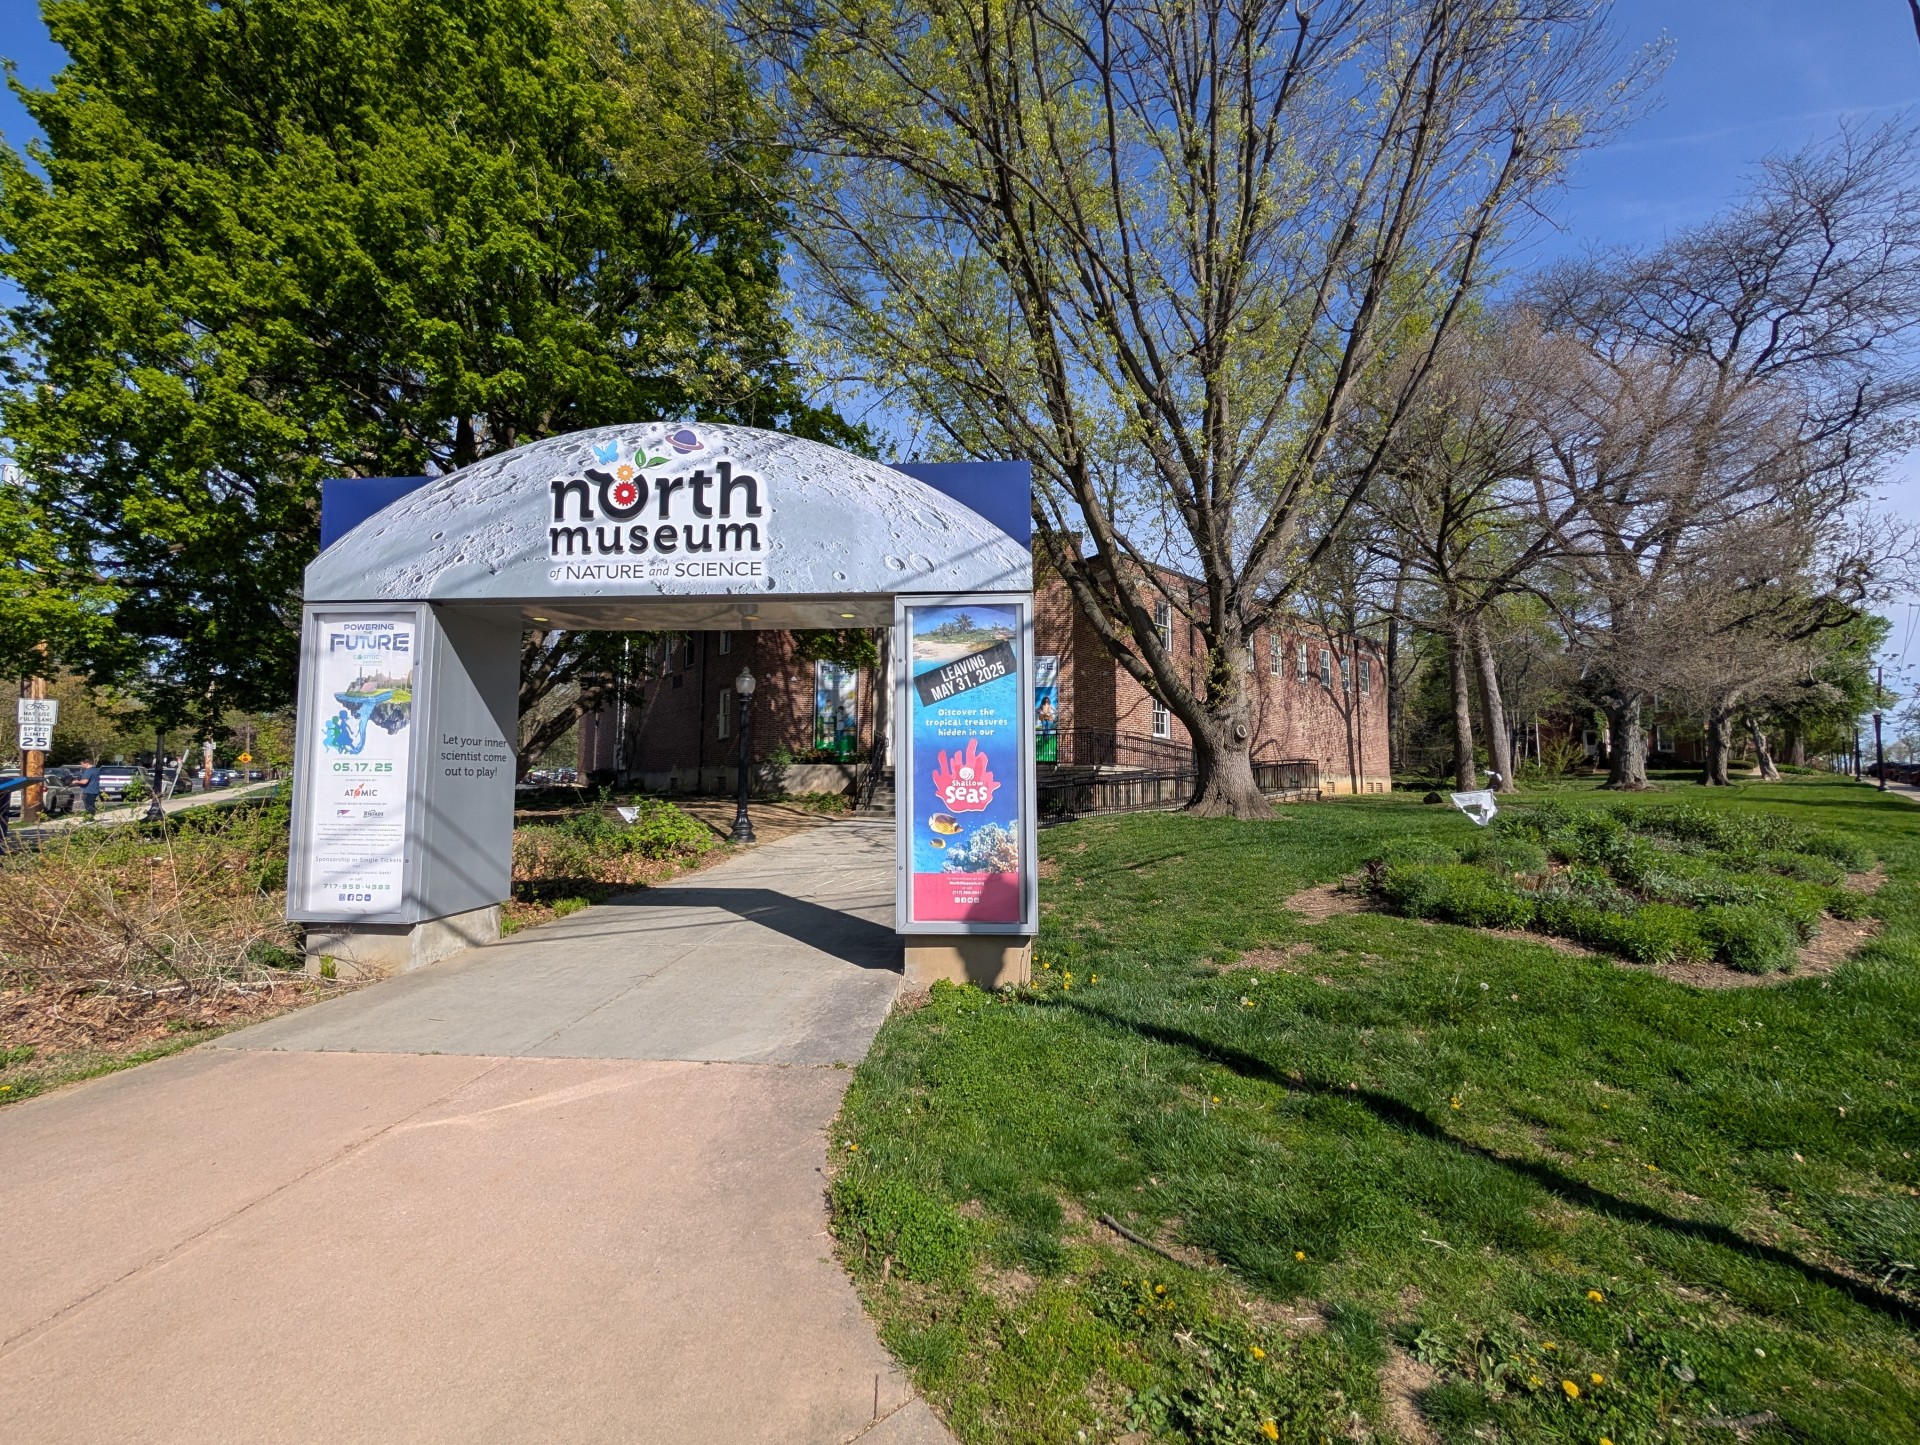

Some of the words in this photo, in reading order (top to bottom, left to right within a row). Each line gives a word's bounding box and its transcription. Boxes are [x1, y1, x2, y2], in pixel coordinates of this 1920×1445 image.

[551, 462, 763, 521] north
[549, 522, 762, 555] museum
[550, 568, 562, 580] of
[566, 564, 644, 579] NATURE
[649, 565, 669, 576] and
[675, 562, 762, 577] SCIENCE
[330, 633, 409, 652] FUTURE
[940, 654, 986, 682] LEAVING
[931, 681, 955, 701] MAY
[956, 674, 976, 691] 31,
[976, 661, 1005, 683] 2025
[980, 708, 994, 716] the
[925, 719, 961, 727] tropical
[22, 737, 47, 747] 25
[443, 733, 458, 745] Let
[460, 737, 482, 748] your
[484, 737, 507, 748] inner
[441, 750, 481, 761] scientist
[484, 754, 507, 762] come
[333, 763, 392, 772] 05.17.25
[444, 766, 461, 776] out
[464, 767, 474, 776] to
[476, 766, 497, 779] play!
[952, 779, 984, 787] Shallow
[344, 789, 378, 797] ATOMIC
[945, 785, 988, 804] Seas
